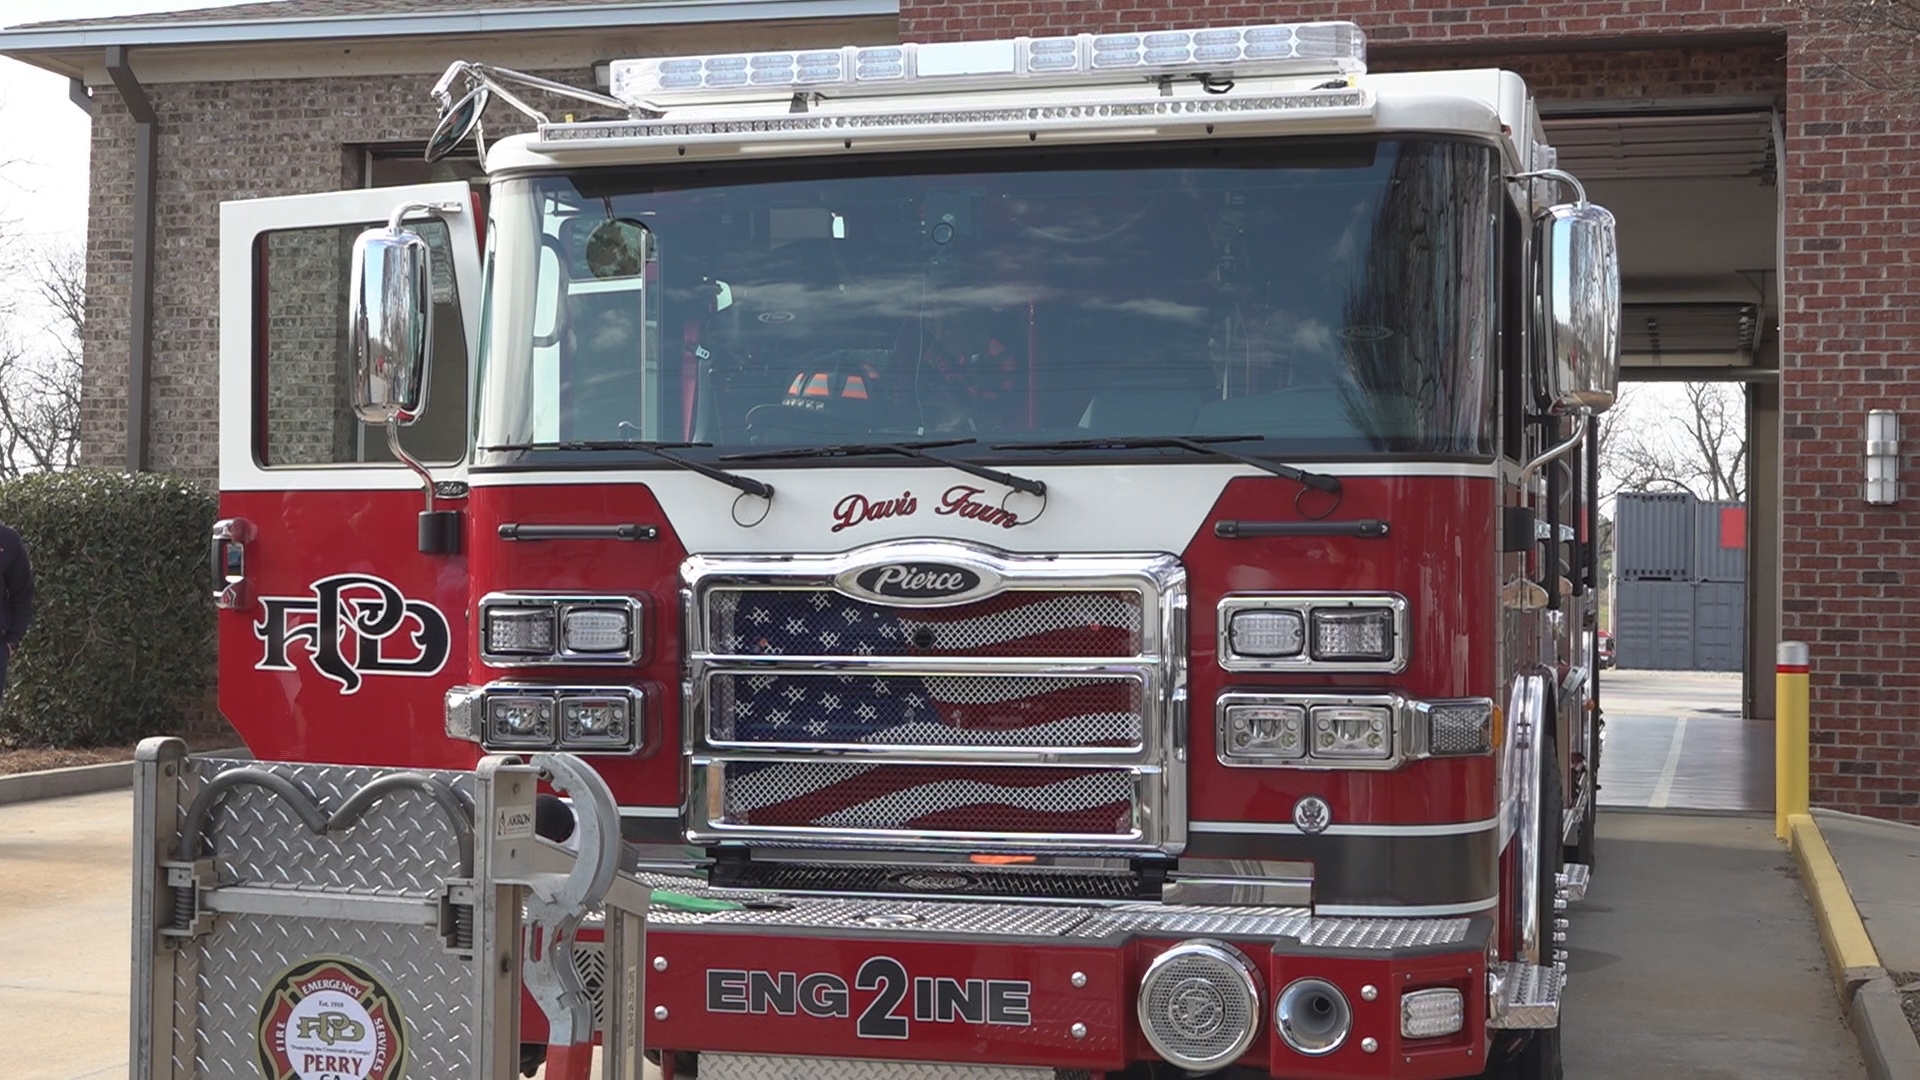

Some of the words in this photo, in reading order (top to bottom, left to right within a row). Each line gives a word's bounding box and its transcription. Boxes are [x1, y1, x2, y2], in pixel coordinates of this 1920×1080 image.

[831, 491, 917, 532] Davis
[935, 486, 1018, 529] Farm
[874, 565, 964, 594] Pierce
[301, 979, 362, 998] EMERGENCY
[276, 1021, 286, 1052] FIRE
[373, 1017, 387, 1072] SERVICES
[303, 1054, 363, 1078] PERRY
